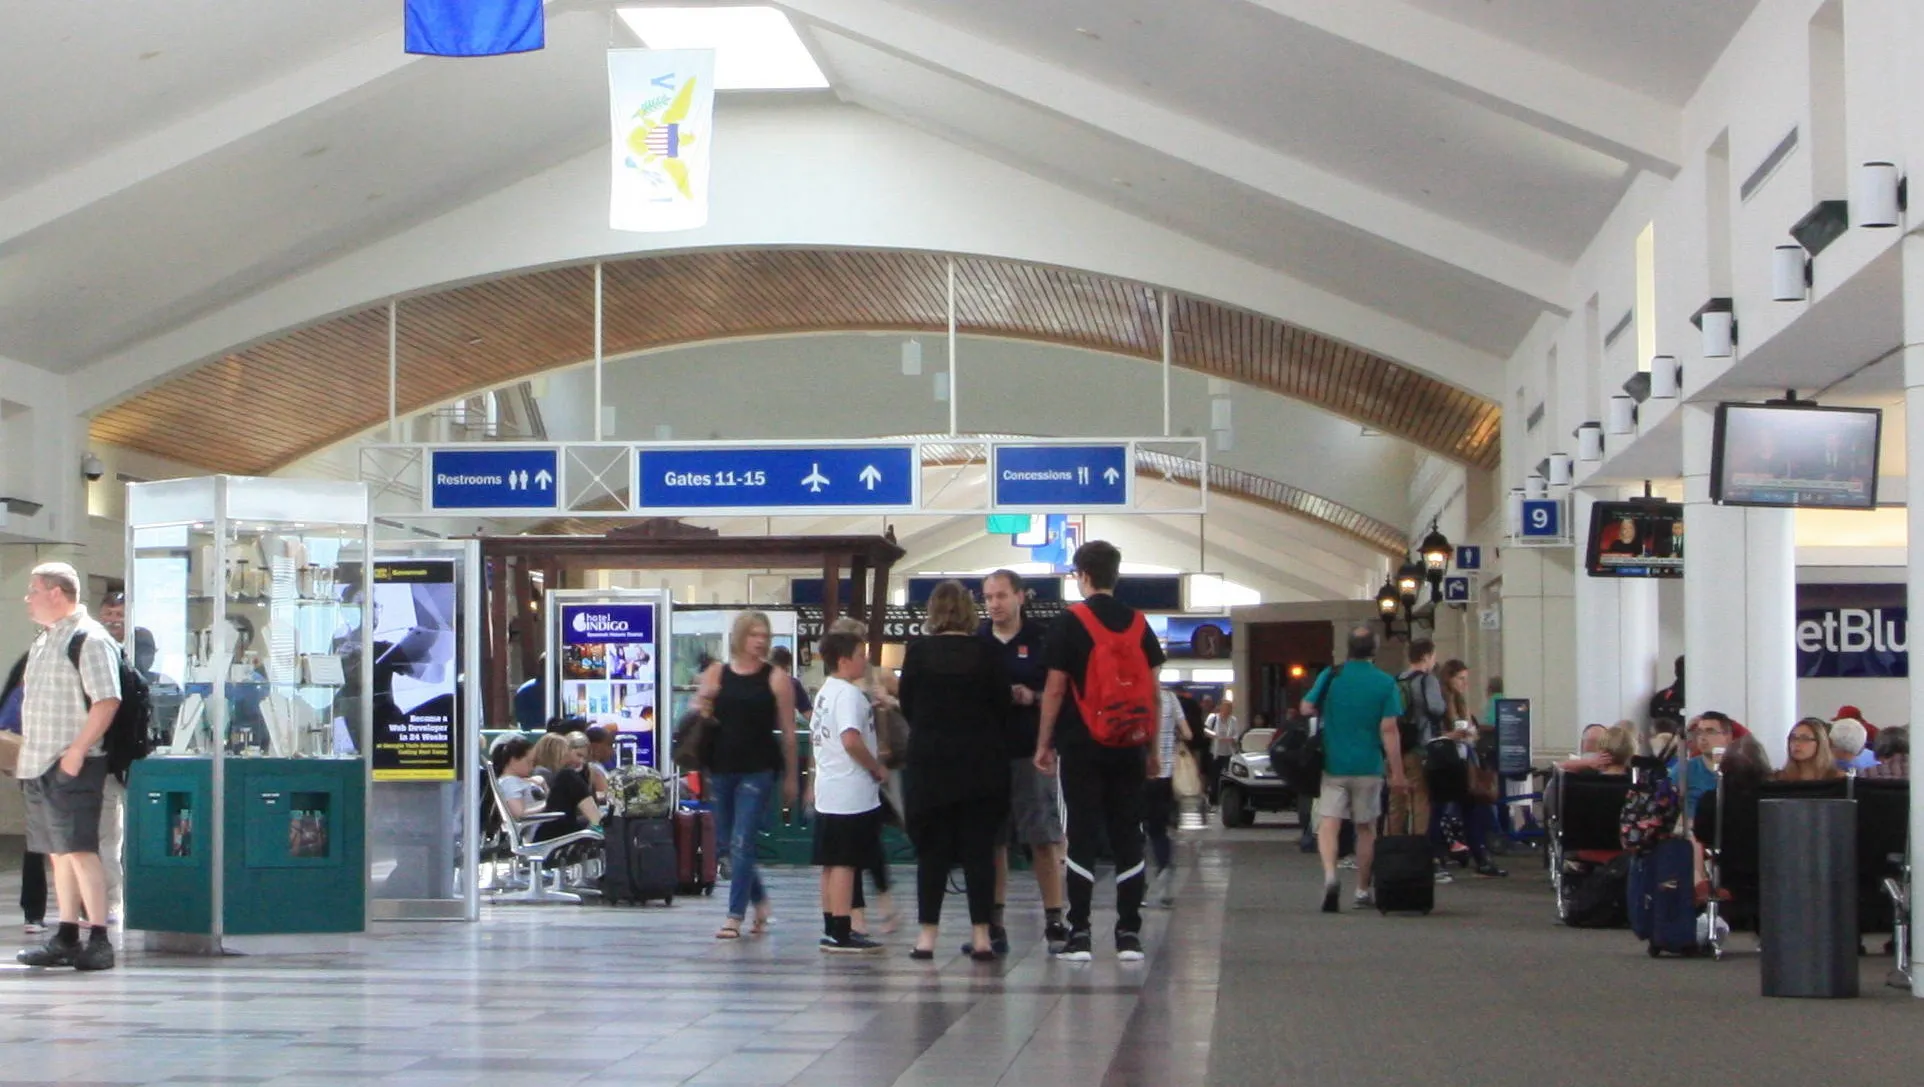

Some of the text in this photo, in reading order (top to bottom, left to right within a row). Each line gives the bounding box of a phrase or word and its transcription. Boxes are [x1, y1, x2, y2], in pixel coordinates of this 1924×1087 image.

[437, 473, 502, 485] Restrooms
[665, 471, 766, 486] Gates 11-15
[1003, 469, 1073, 481] Concessions
[1532, 508, 1548, 529] 9
[586, 612, 611, 622] hotel
[1796, 608, 1908, 653] etBlu
